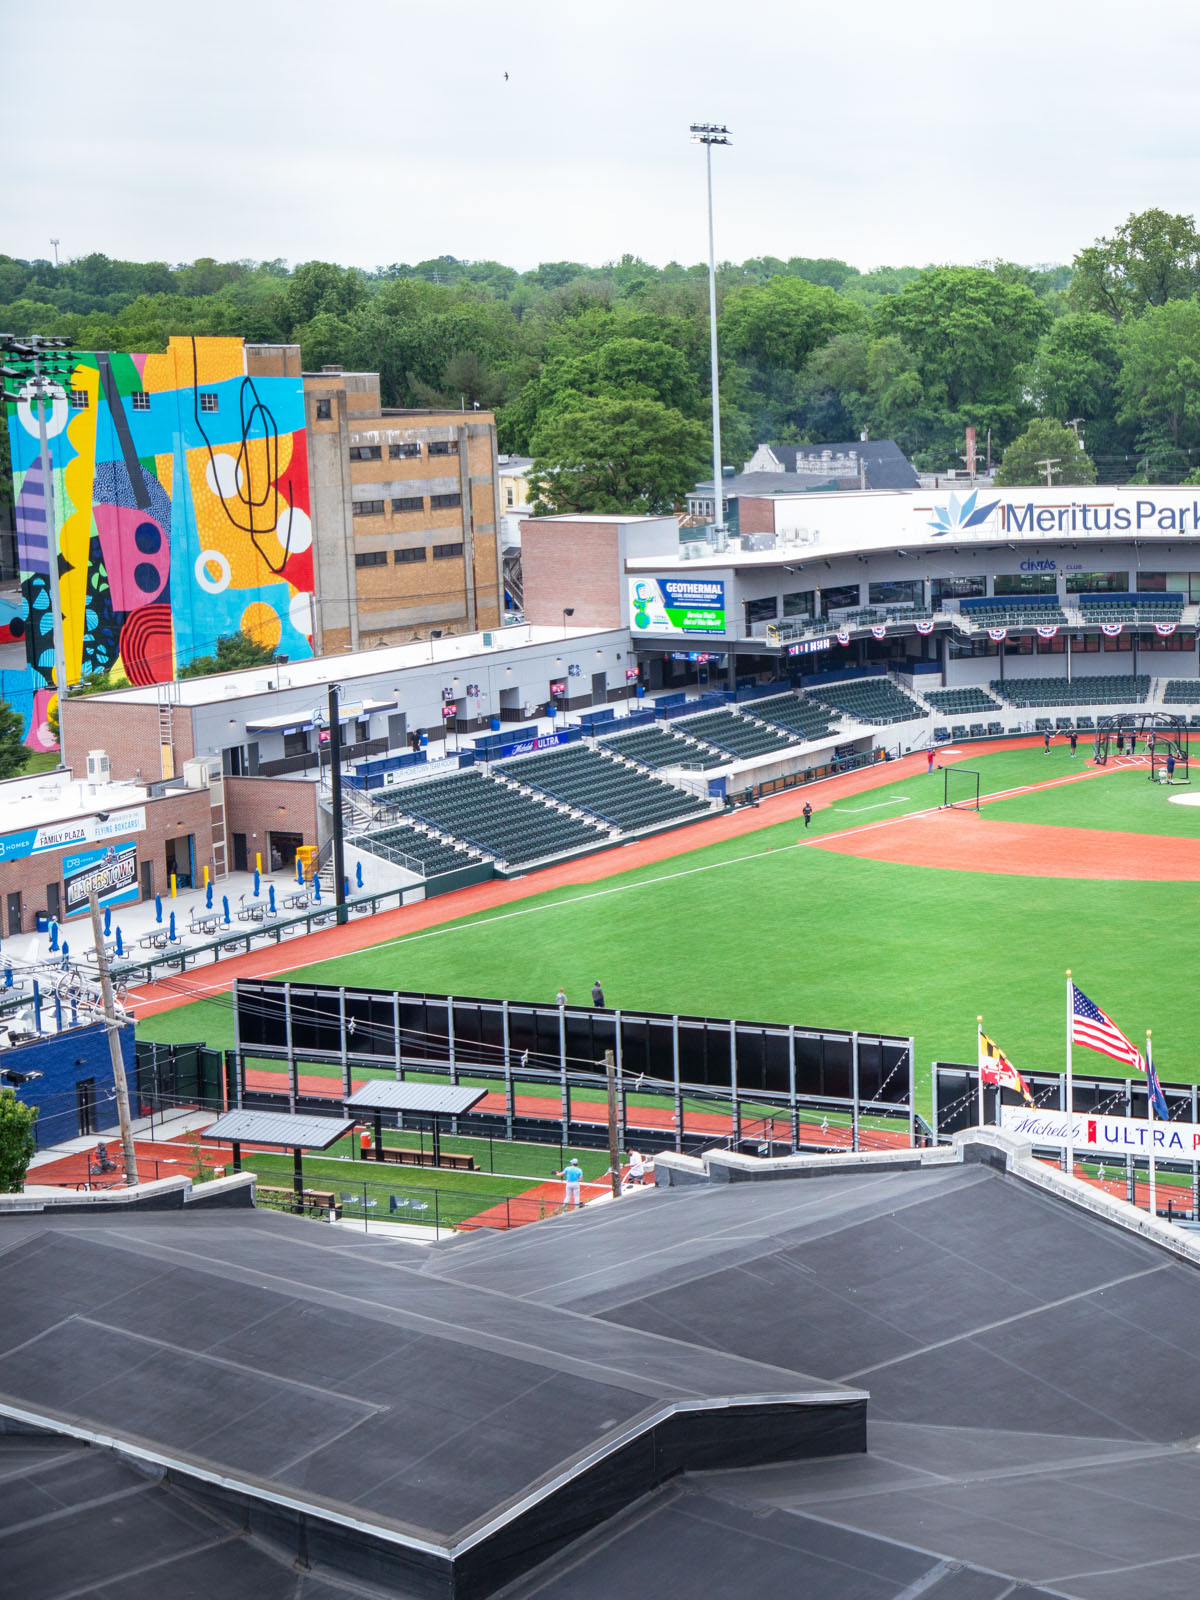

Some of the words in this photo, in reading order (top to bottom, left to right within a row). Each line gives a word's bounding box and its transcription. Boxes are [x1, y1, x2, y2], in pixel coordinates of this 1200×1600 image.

[1020, 558, 1056, 571] CINTAS
[666, 583, 722, 594] GEOTHERMAL
[538, 736, 559, 748] ULTRA
[95, 824, 112, 836] FLYING
[40, 834, 62, 846] FAMILY
[65, 829, 85, 840] PLAZA
[6, 840, 30, 850] HOMES
[66, 858, 80, 868] DRB
[70, 860, 134, 900] HAGERSTOWN
[1011, 1116, 1083, 1138] Michelob
[1104, 1125, 1184, 1150] ULTRA
